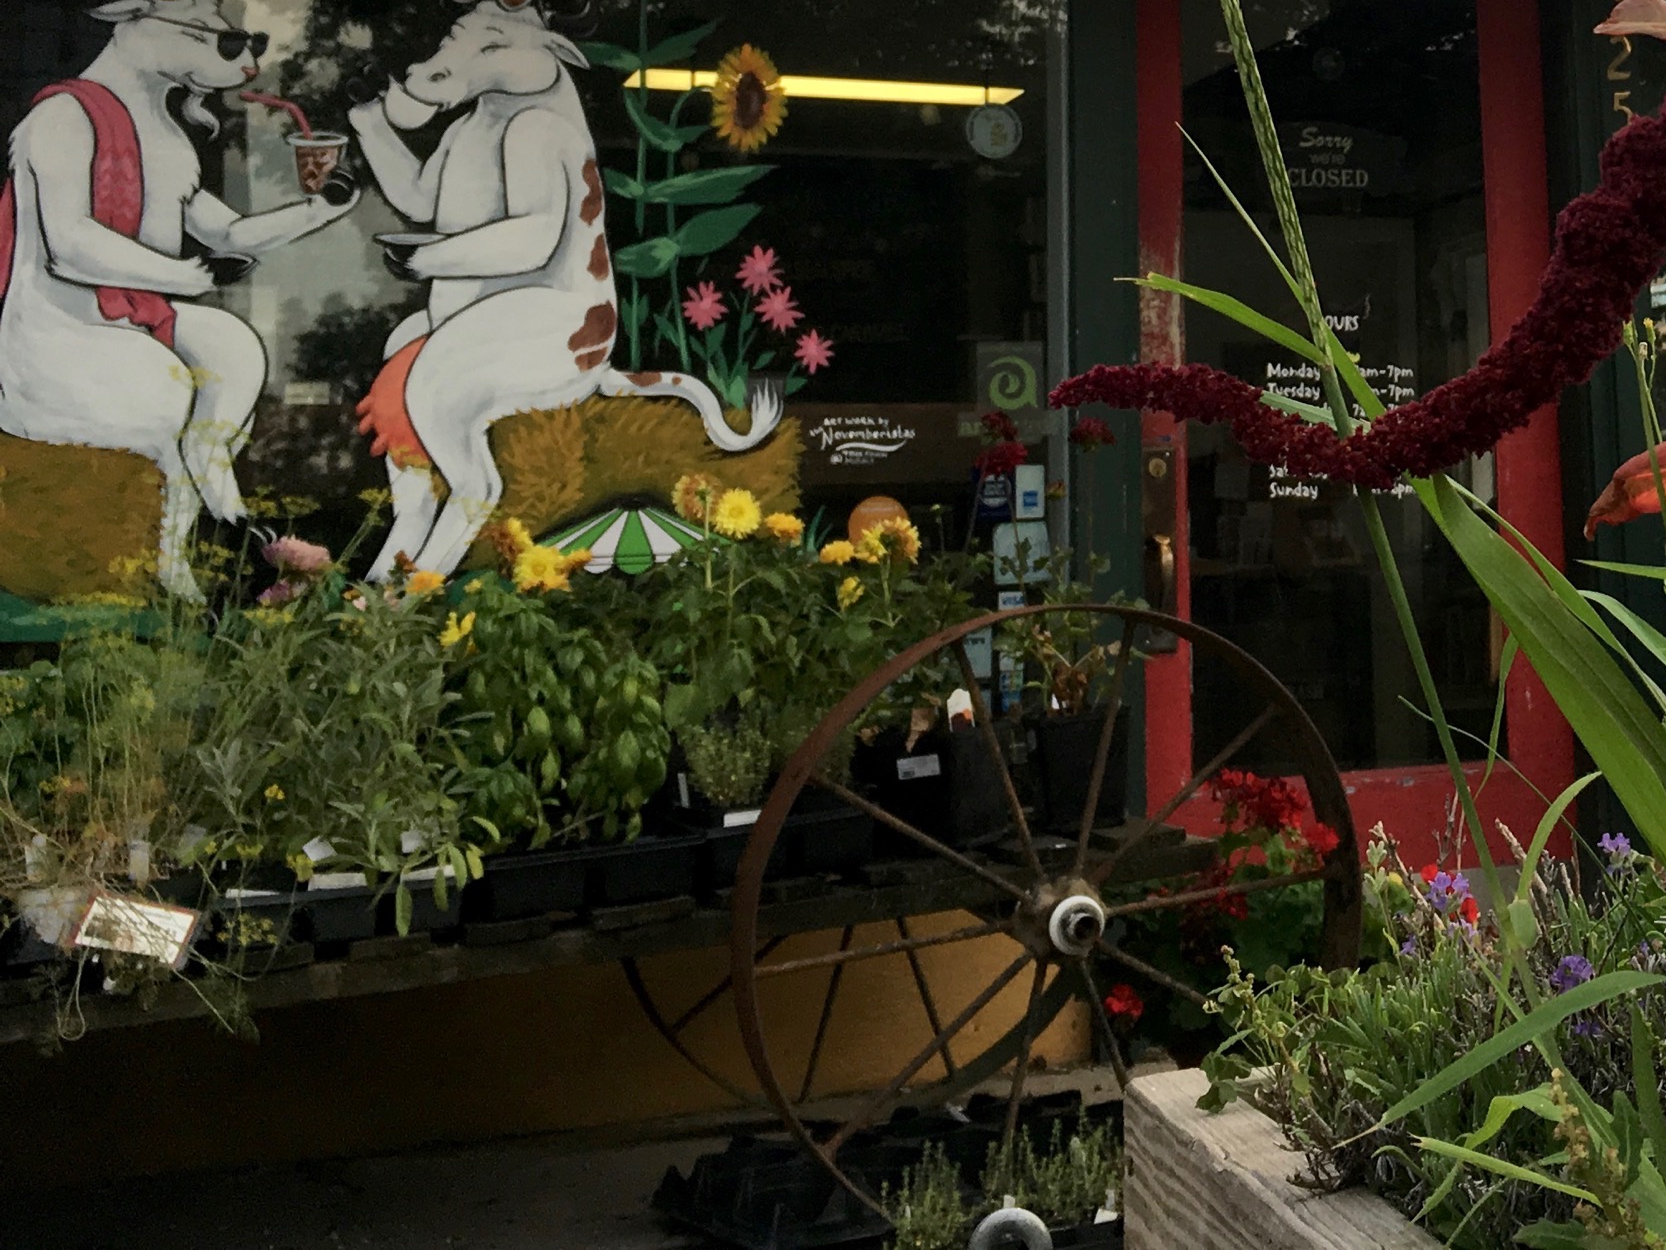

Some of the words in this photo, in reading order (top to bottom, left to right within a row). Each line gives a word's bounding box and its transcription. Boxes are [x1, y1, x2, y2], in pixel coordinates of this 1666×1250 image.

[1299, 127, 1353, 154] Sorry
[1288, 168, 1369, 187] CLOSED
[1323, 315, 1360, 332] OURS
[1266, 362, 1321, 381] Monday
[1266, 382, 1321, 400] Tuesday
[1269, 481, 1319, 500] Sunday
